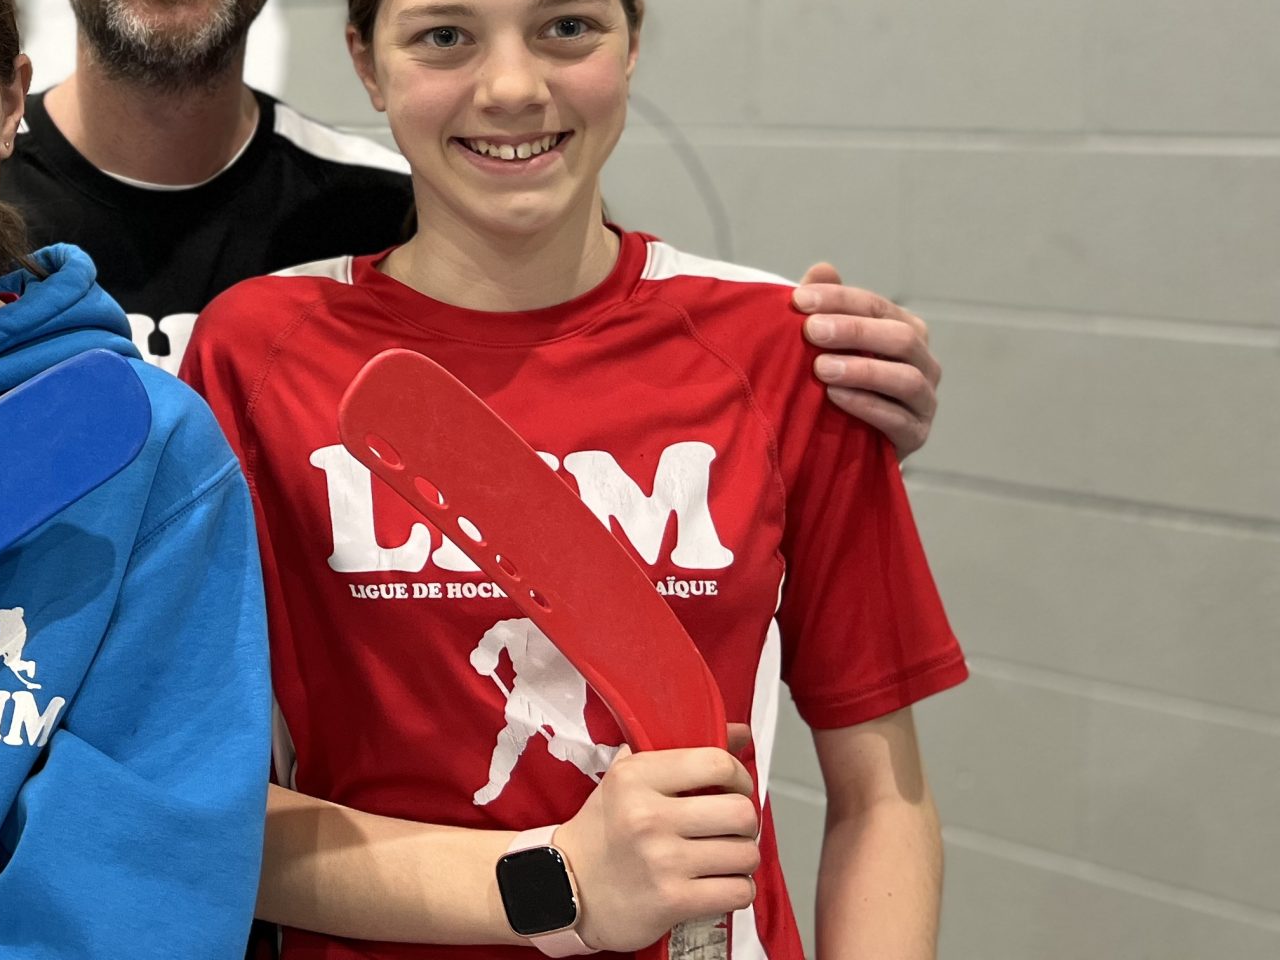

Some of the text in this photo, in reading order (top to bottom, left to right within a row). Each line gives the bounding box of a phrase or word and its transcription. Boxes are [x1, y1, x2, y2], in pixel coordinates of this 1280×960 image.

[310, 441, 734, 572] LM
[349, 583, 409, 599] LIGUE
[412, 582, 443, 599] DE
[656, 576, 718, 598] AÏQUE
